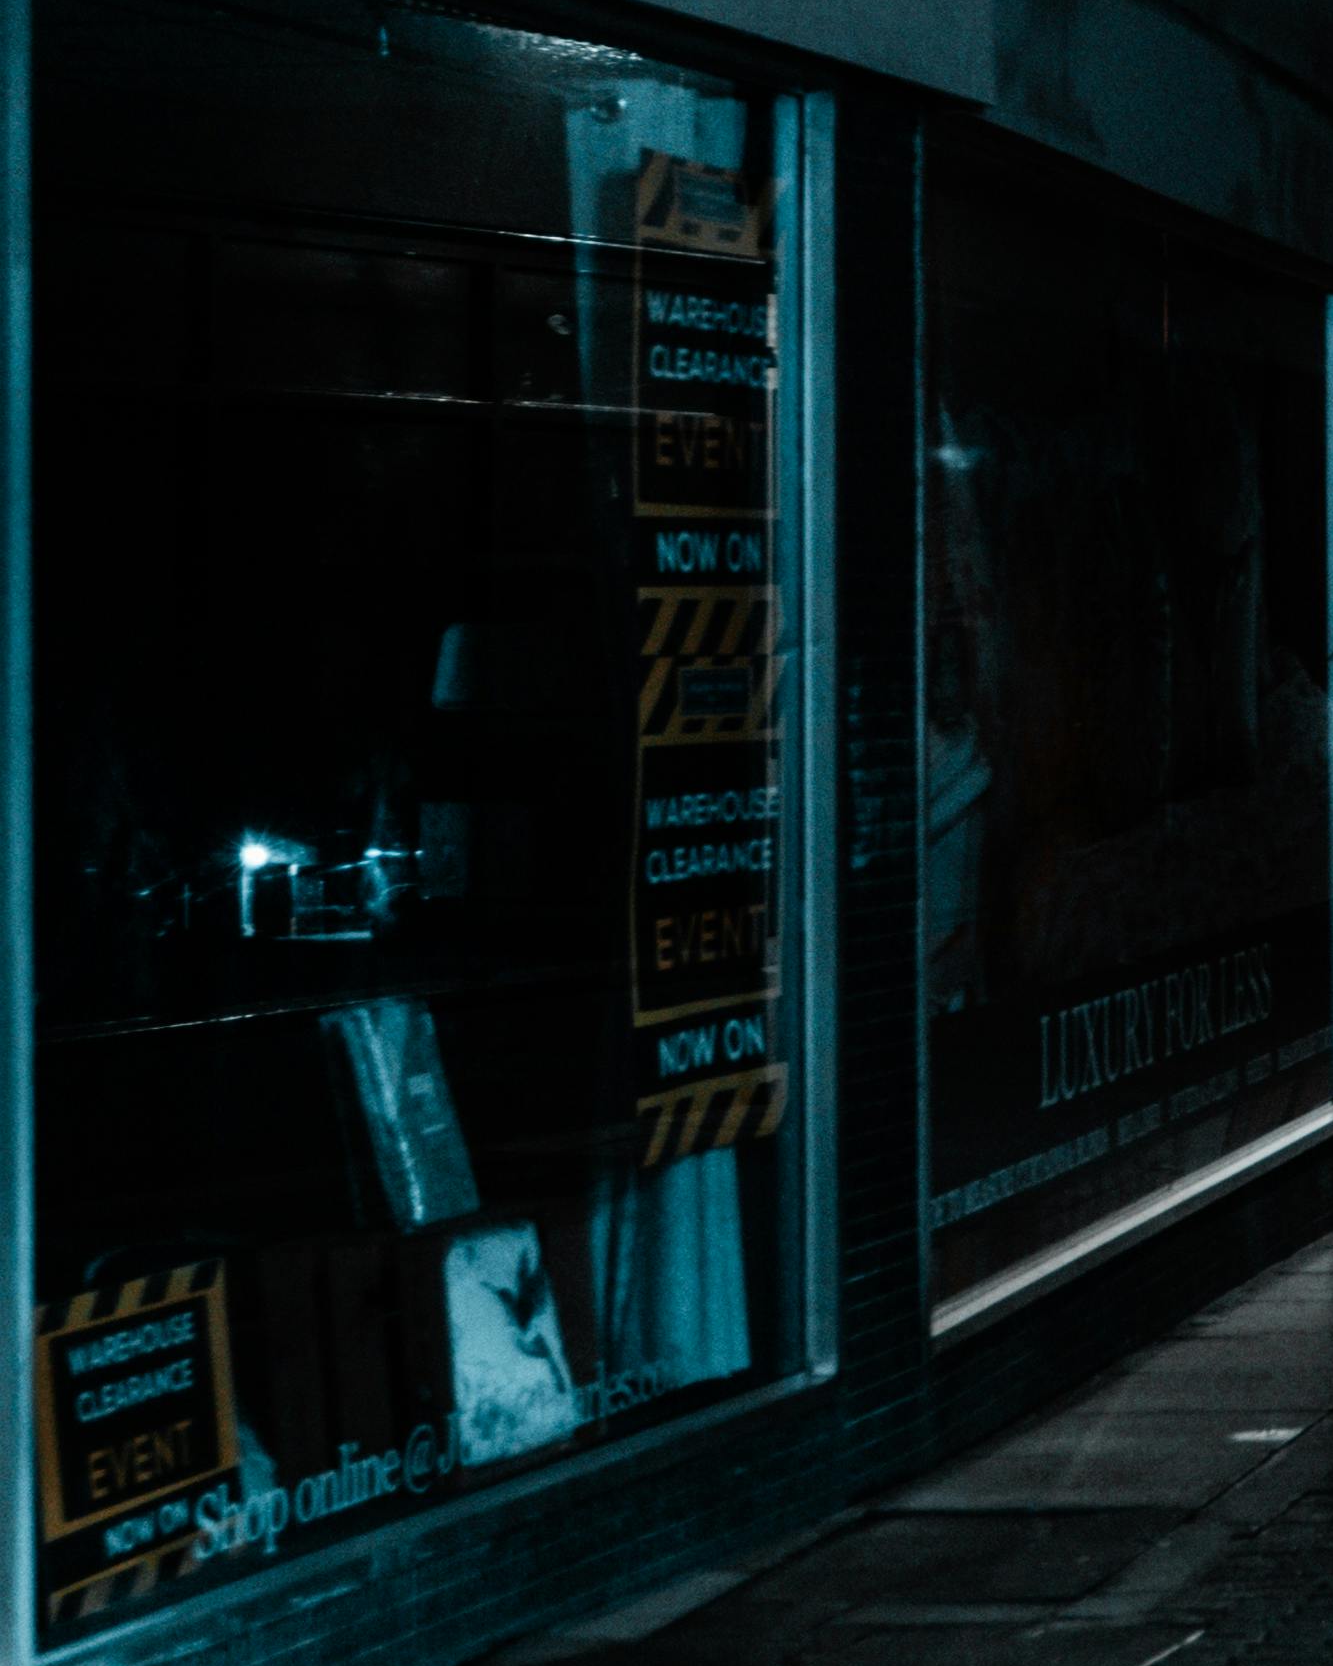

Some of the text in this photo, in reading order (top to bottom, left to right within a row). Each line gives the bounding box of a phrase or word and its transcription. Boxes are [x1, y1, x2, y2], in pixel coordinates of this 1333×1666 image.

[655, 529, 764, 574] NOW ON
[644, 785, 782, 831] WAREHOUSE
[644, 837, 773, 885] CLEARANCE
[655, 903, 768, 974] EVENT
[656, 1014, 767, 1080] NOW ON
[1037, 980, 1159, 1111] LUXURY
[1164, 961, 1214, 1059] FOR
[1218, 940, 1272, 1035] LESS
[66, 1310, 197, 1377] WAREHOUSE
[75, 1356, 196, 1424] CLEARANCE
[88, 1418, 194, 1501] EVENT
[103, 1497, 192, 1560] NOW ON
